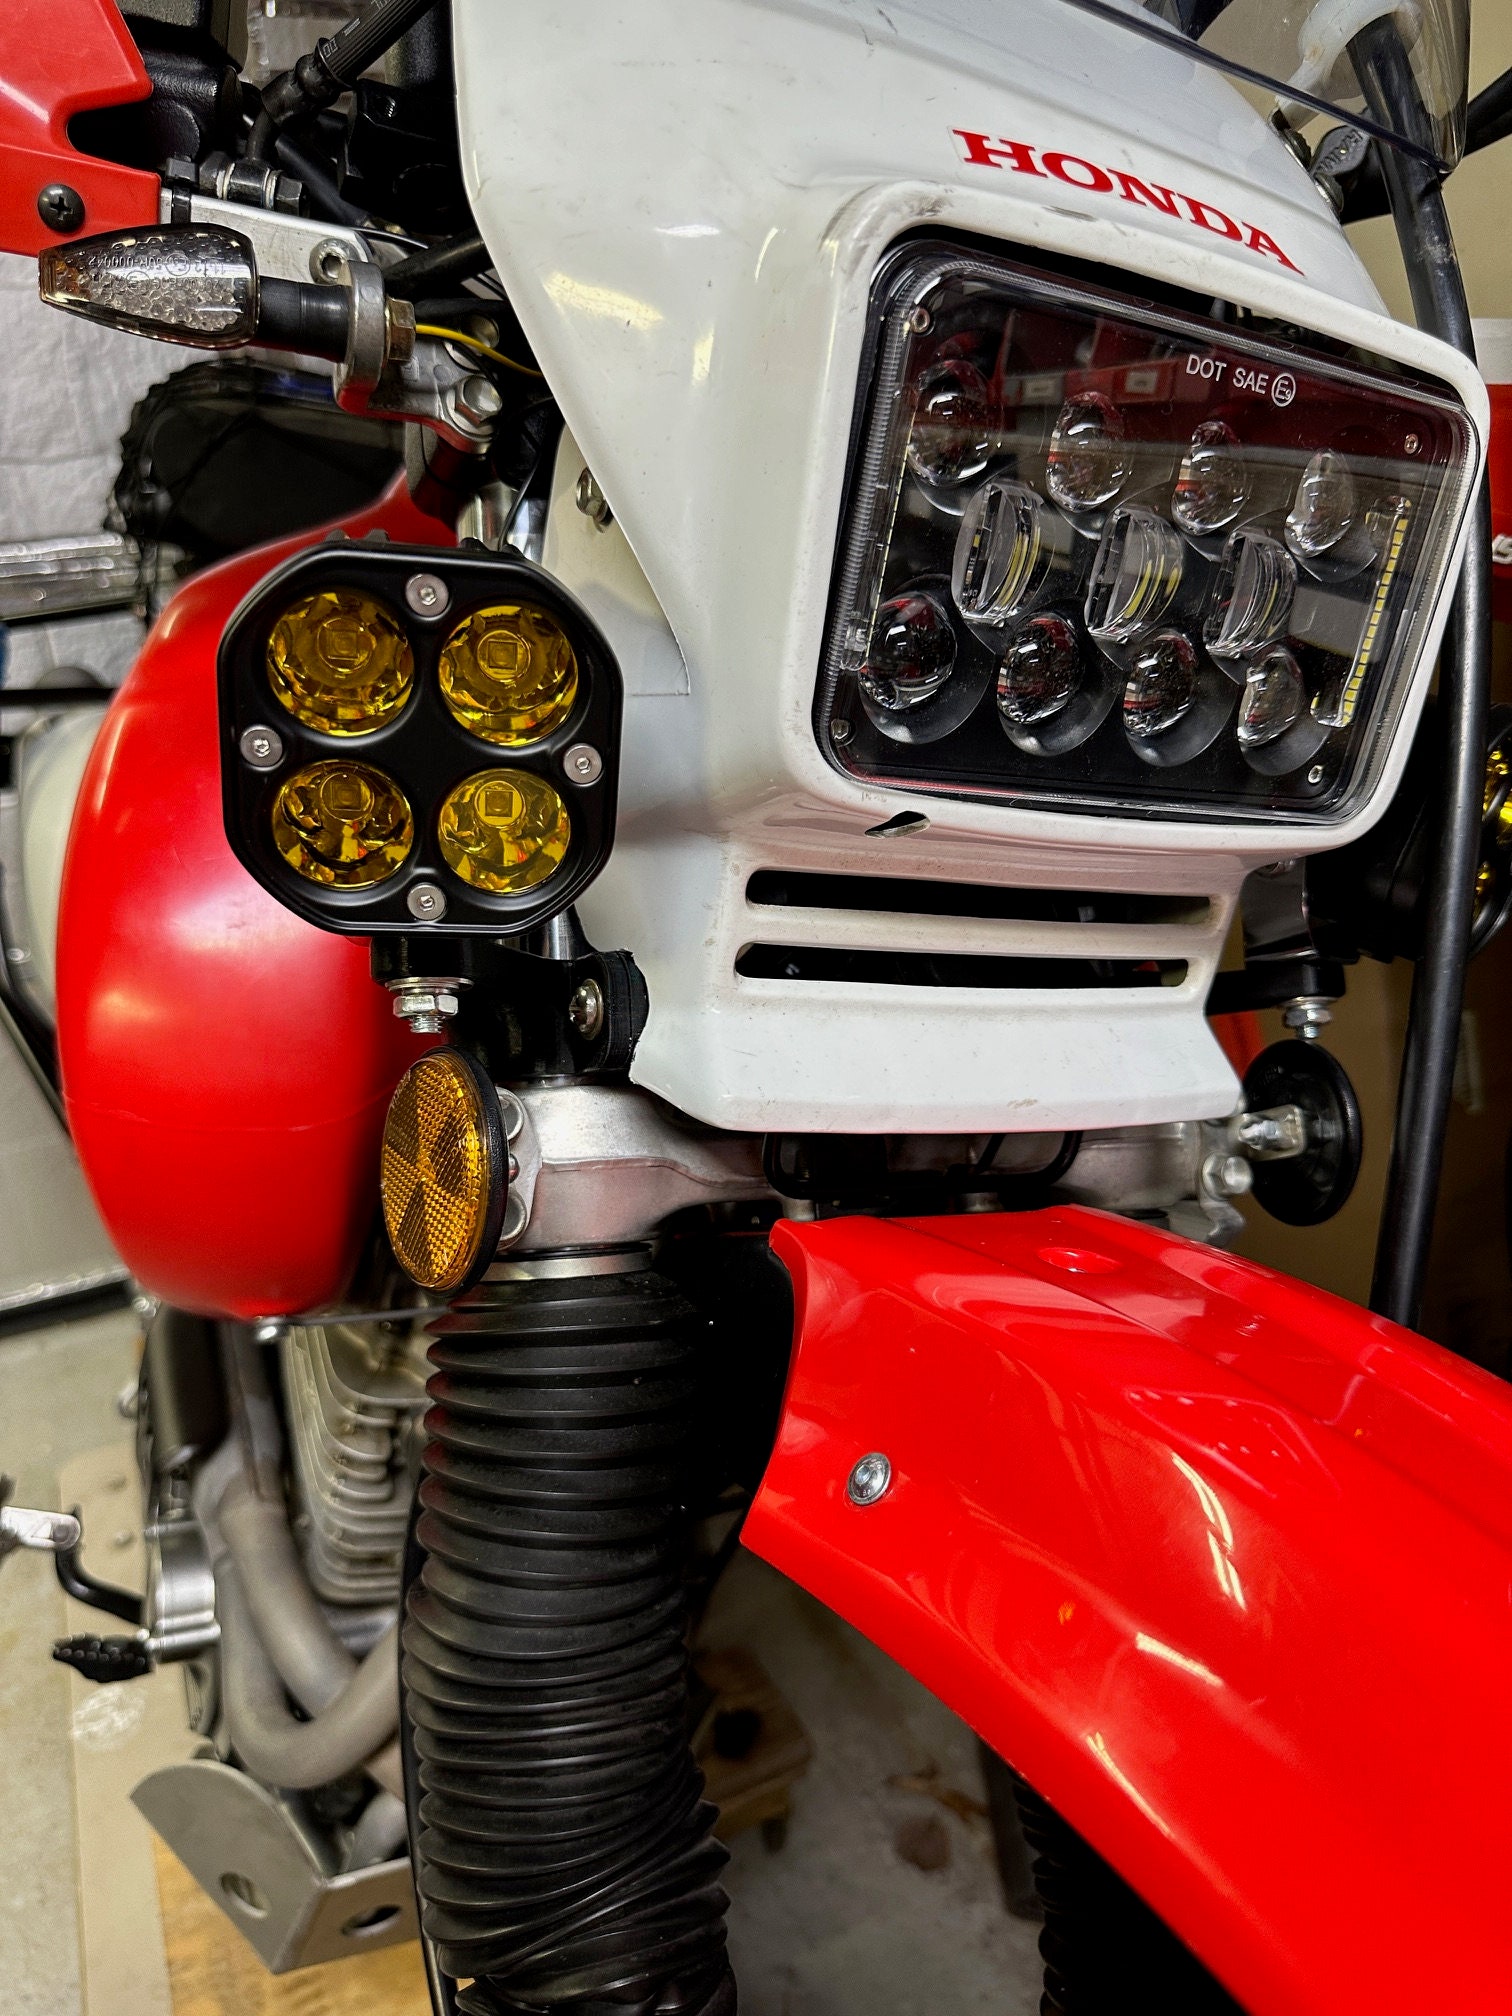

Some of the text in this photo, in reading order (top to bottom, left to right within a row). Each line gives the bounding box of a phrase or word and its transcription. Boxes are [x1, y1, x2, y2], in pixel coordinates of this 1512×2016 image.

[953, 129, 1305, 277] HONDA
[1186, 354, 1294, 404] DOT SAE E9
